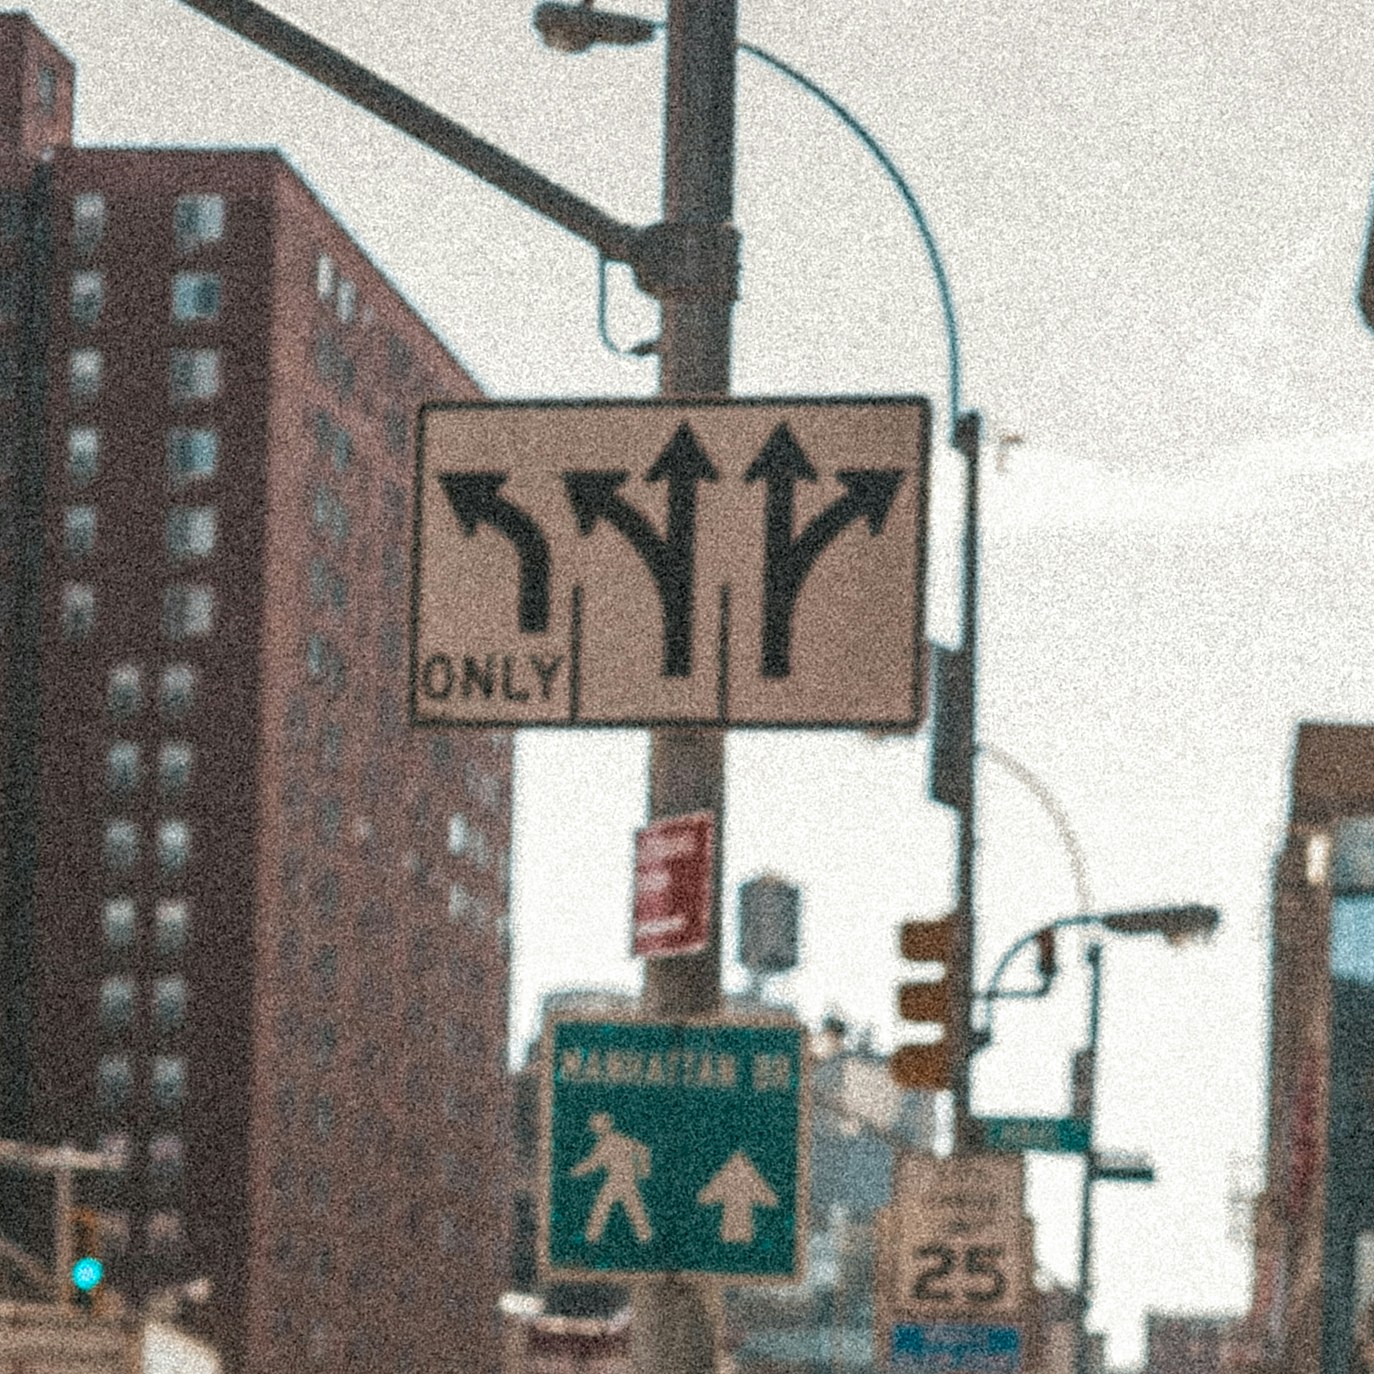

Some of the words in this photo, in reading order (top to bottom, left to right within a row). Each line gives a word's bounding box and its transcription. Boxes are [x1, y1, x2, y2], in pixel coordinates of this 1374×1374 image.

[423, 653, 563, 700] ONLY
[560, 1047, 737, 1090] MANHATTAN
[913, 1245, 1006, 1302] 25
